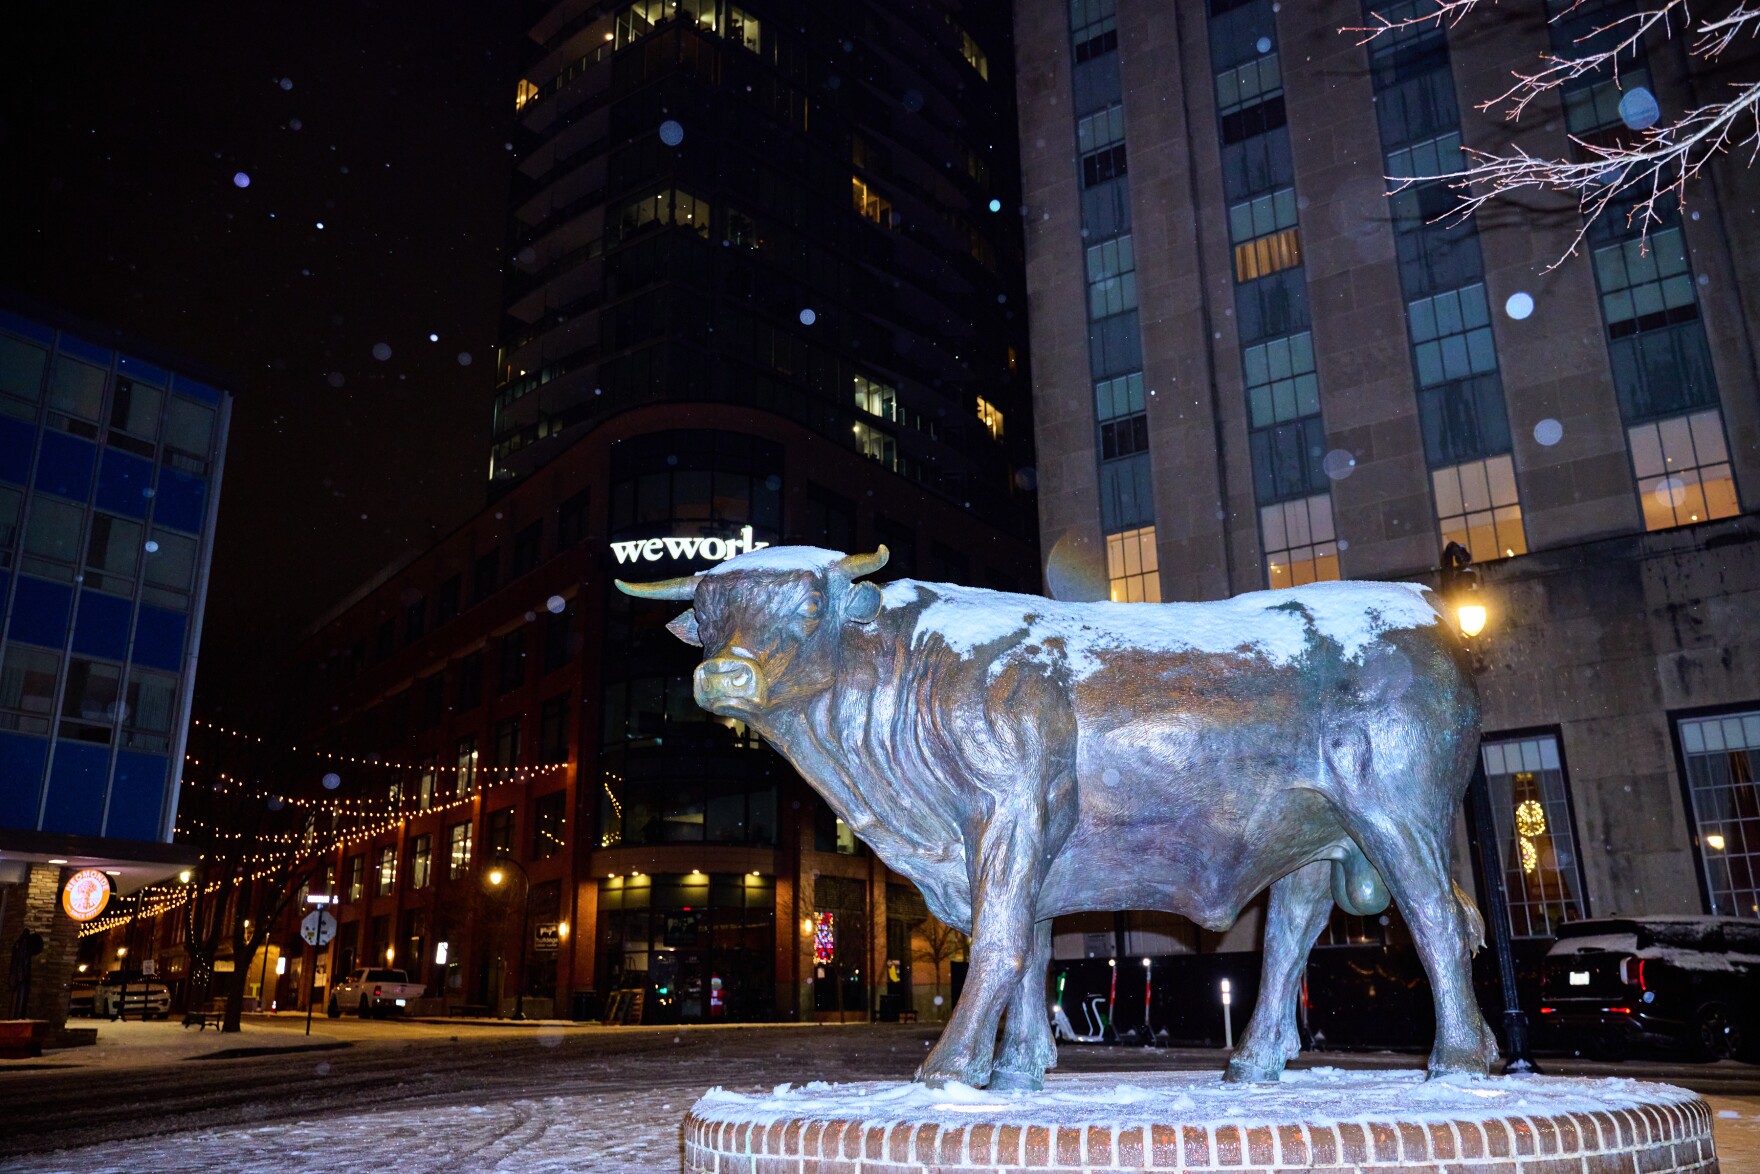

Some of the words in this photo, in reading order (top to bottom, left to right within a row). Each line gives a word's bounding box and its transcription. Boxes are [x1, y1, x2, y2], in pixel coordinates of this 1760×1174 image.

[610, 525, 769, 564] wework
[66, 870, 110, 890] NEOMONDE
[70, 909, 84, 919] SINCE
